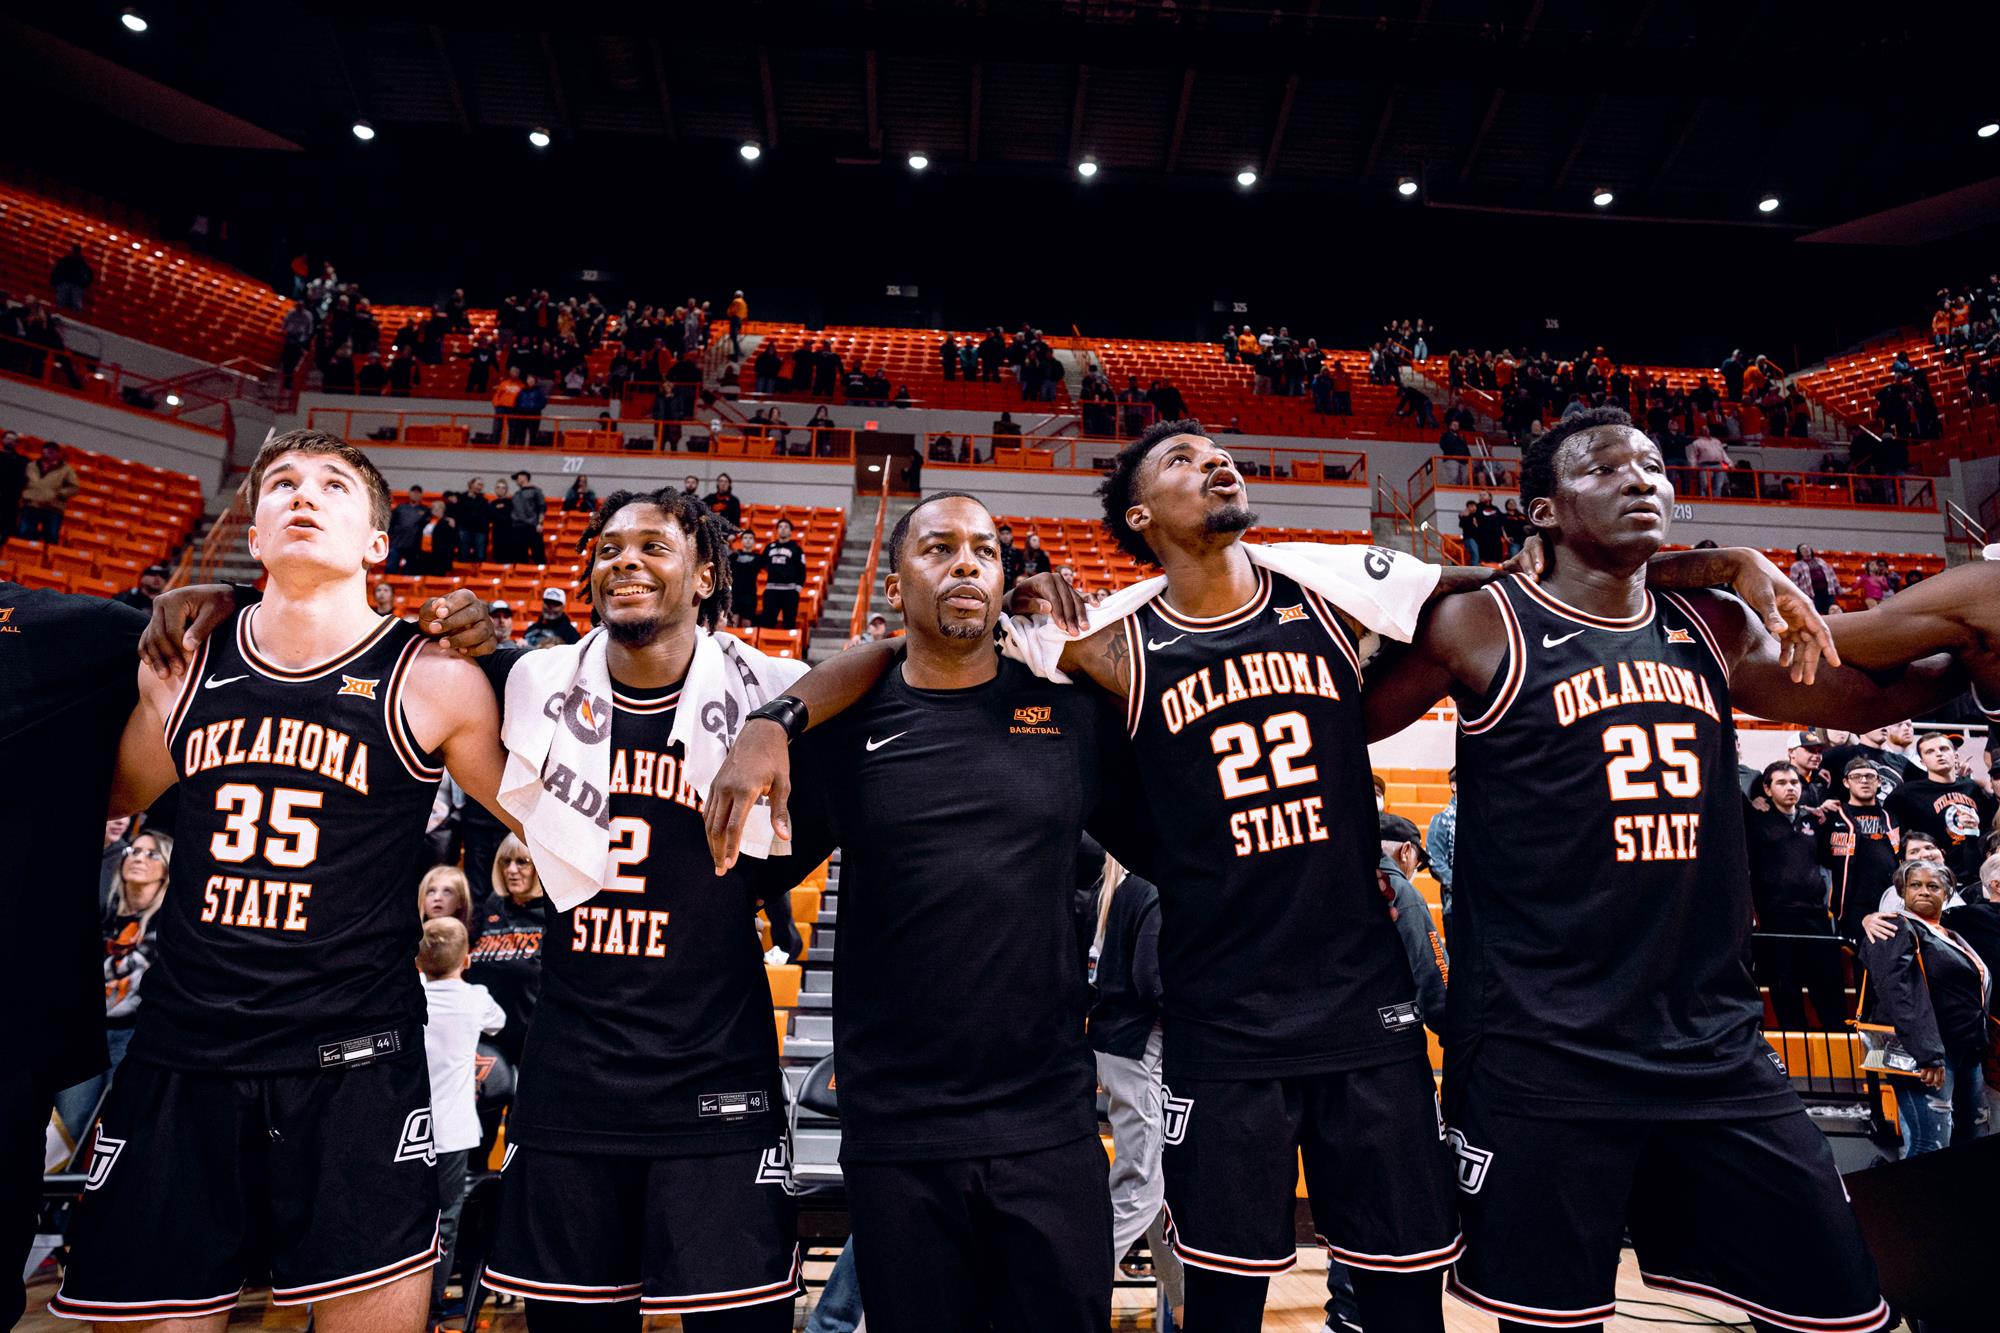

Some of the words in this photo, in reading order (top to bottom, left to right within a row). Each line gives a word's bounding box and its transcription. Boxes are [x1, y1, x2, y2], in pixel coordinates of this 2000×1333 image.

[562, 456, 584, 472] 217
[1674, 504, 1692, 520] 219
[1014, 707, 1051, 725] OSU
[1161, 652, 1340, 735] OKLAHOMA
[1553, 660, 1721, 727] OKLAHOMA
[185, 717, 369, 796] OKLAHOMA
[1010, 727, 1061, 735] BASKETBALL
[1210, 711, 1318, 800] 22
[1602, 723, 1702, 801] 25
[210, 783, 324, 868] 35
[1230, 796, 1329, 857] STATE
[1614, 814, 1699, 862] STATE
[601, 816, 651, 893] 2
[201, 875, 312, 931] STATE
[572, 907, 669, 957] STATE
[377, 1038, 390, 1048] 44
[750, 1097, 761, 1107] 48
